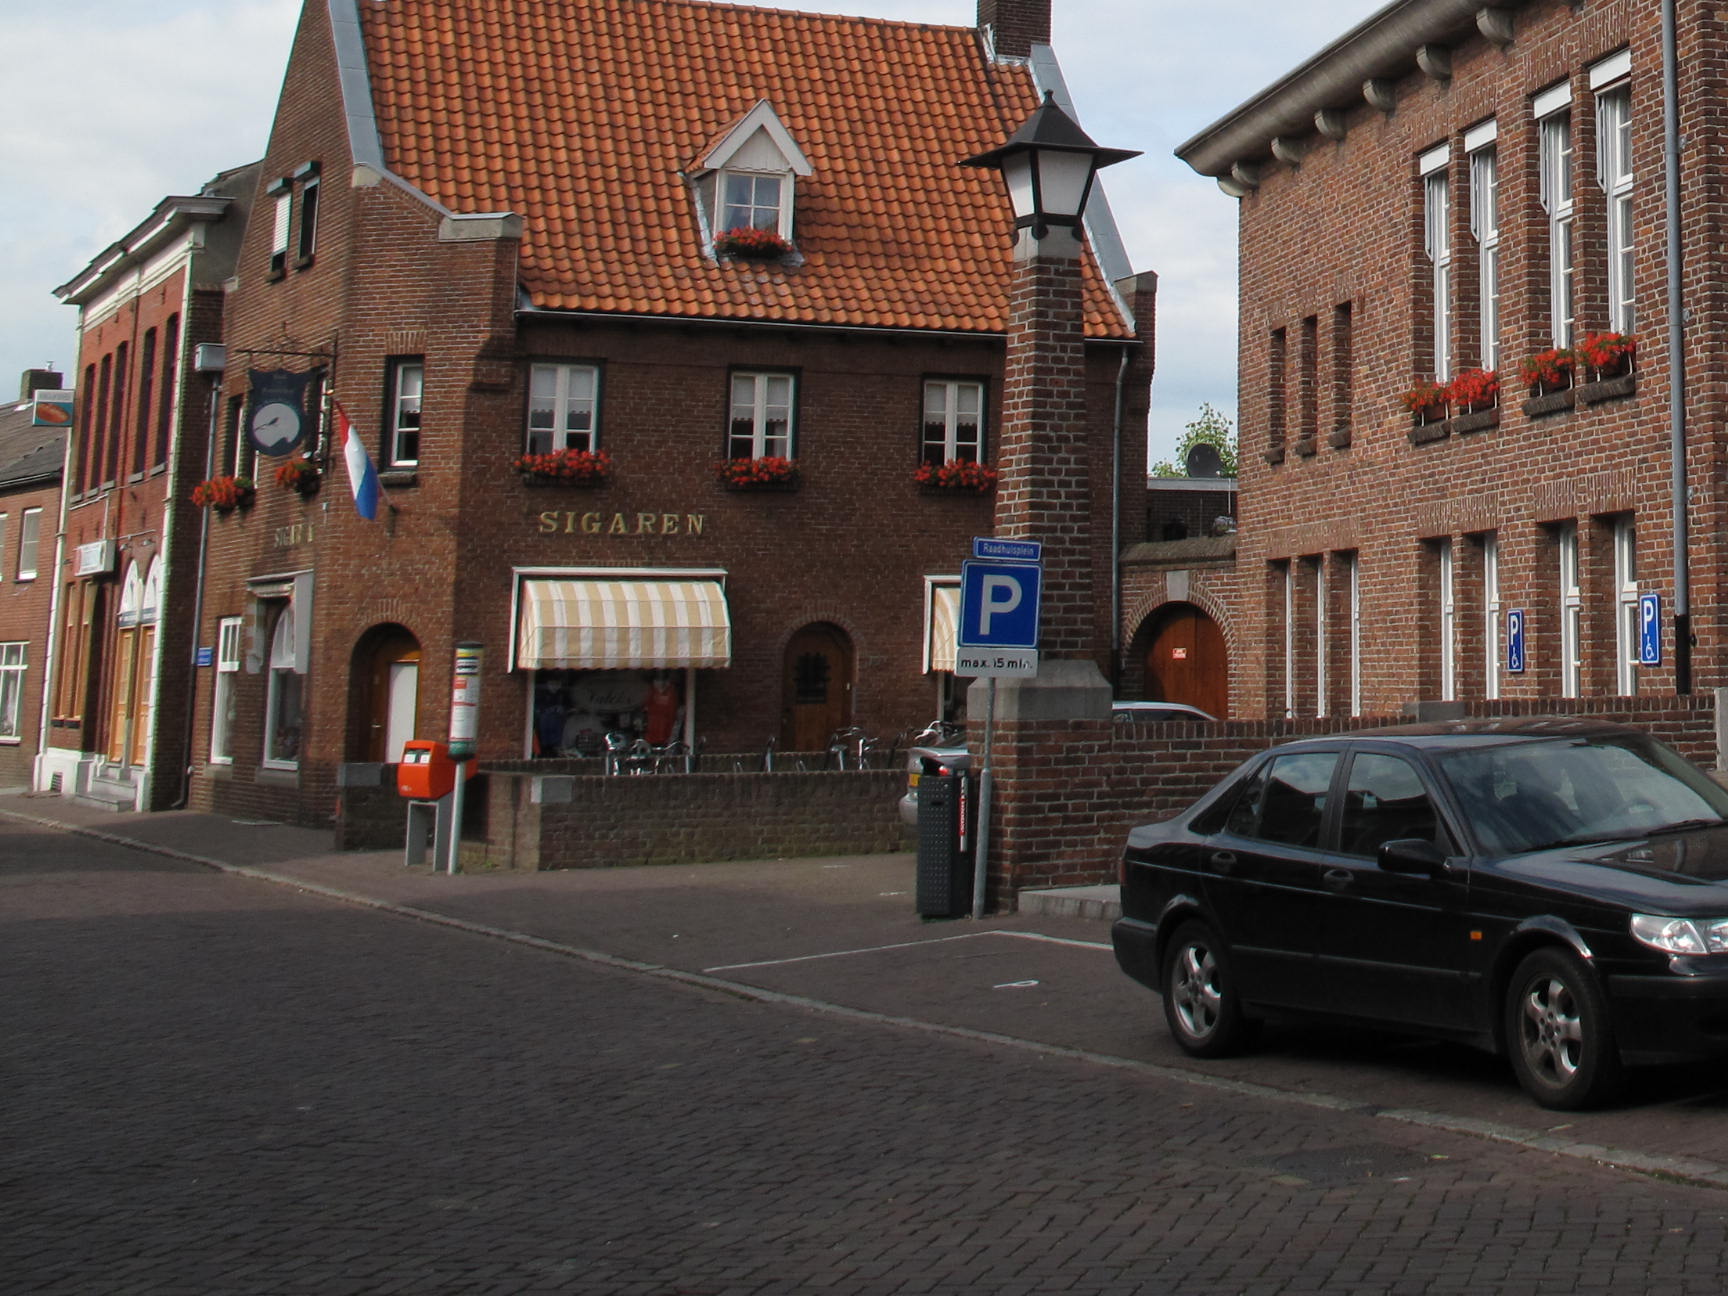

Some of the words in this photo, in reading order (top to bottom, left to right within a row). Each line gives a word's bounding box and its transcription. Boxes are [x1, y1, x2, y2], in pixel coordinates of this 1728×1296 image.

[538, 510, 706, 536] SIGAREN
[983, 542, 1035, 556] Raadhuisplein
[979, 574, 1023, 636] P
[1644, 600, 1654, 634] P
[1510, 615, 1519, 646] P
[993, 656, 1004, 669] 15
